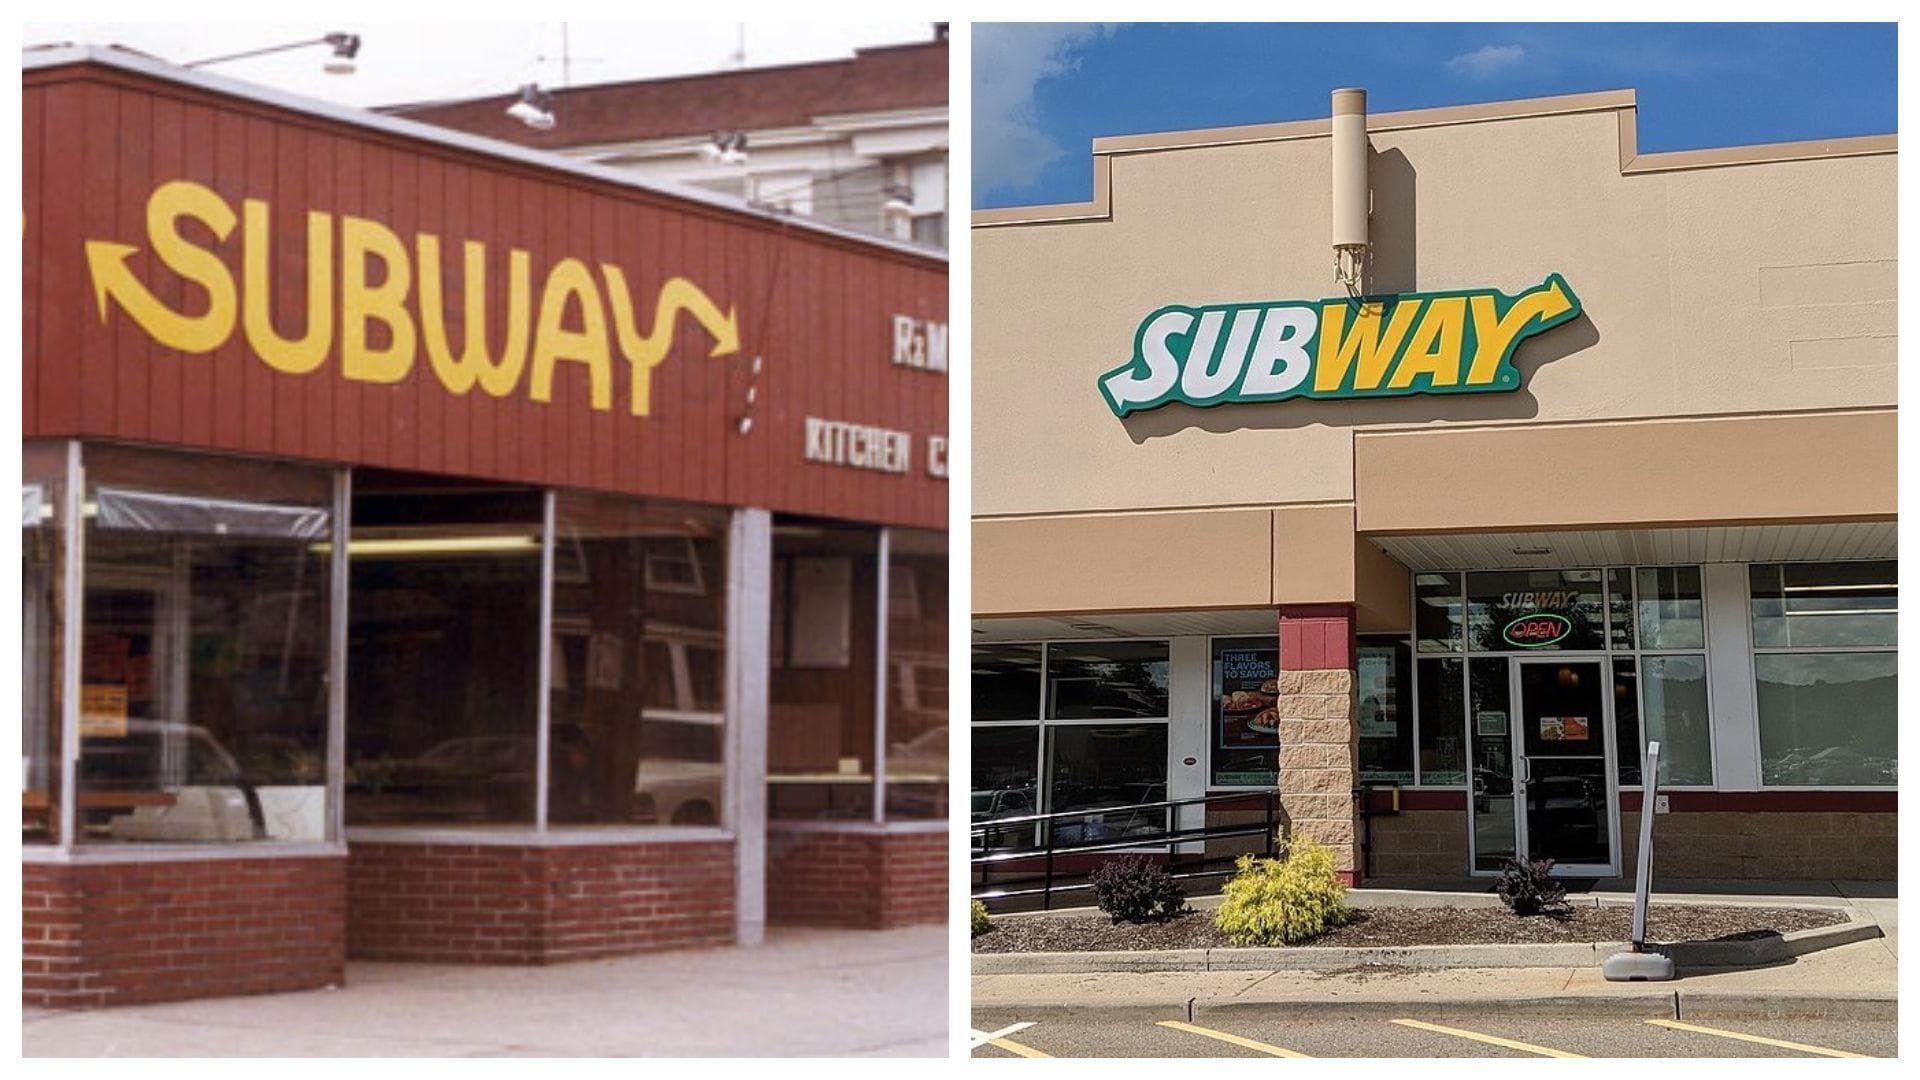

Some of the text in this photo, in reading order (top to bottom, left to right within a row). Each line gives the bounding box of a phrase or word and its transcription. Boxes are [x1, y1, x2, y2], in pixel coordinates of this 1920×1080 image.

[84, 180, 741, 417] SUBWAY
[1104, 280, 1574, 409] SUBWAY
[805, 416, 949, 478] KITCHEN C
[1497, 591, 1579, 609] SUBWAY
[1510, 622, 1562, 638] OPEN
[1224, 653, 1258, 662] THREE
[1224, 661, 1271, 670] FLAVORS
[1224, 670, 1239, 679] TO
